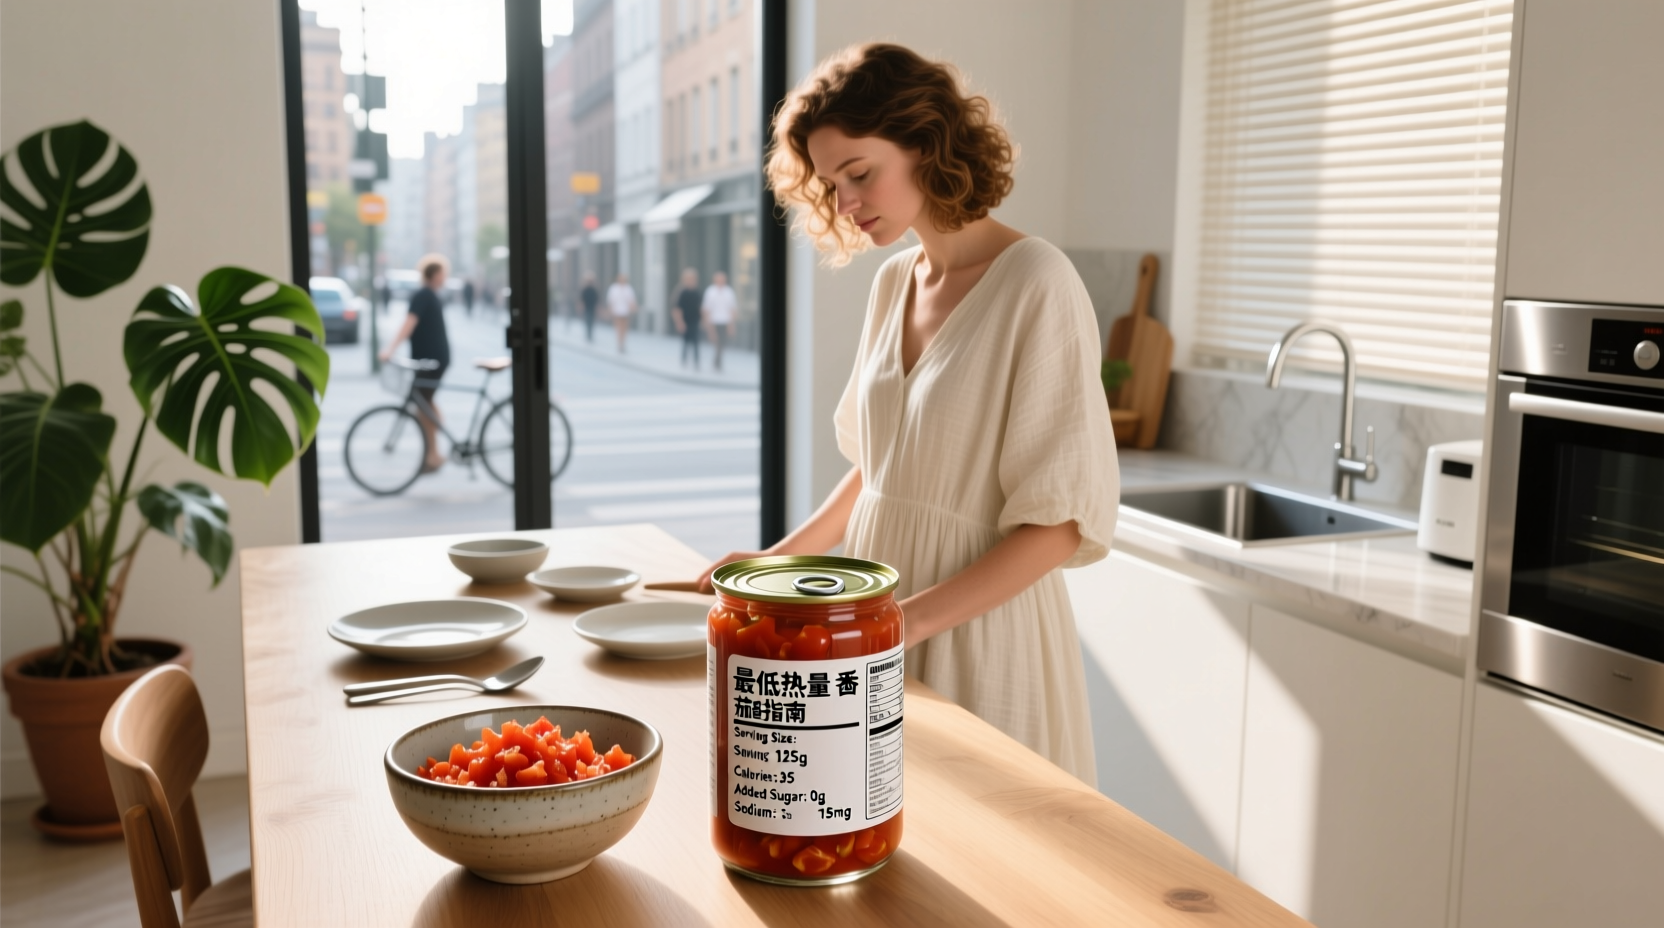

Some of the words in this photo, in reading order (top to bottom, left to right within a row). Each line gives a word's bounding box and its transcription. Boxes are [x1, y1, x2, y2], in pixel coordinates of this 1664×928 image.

[775, 750, 808, 767] 125g
[734, 783, 767, 800] Added
[770, 789, 807, 806] Sugar:
[810, 790, 826, 806] 0g
[734, 801, 777, 819] Sodium:
[818, 807, 852, 821] 15mg
